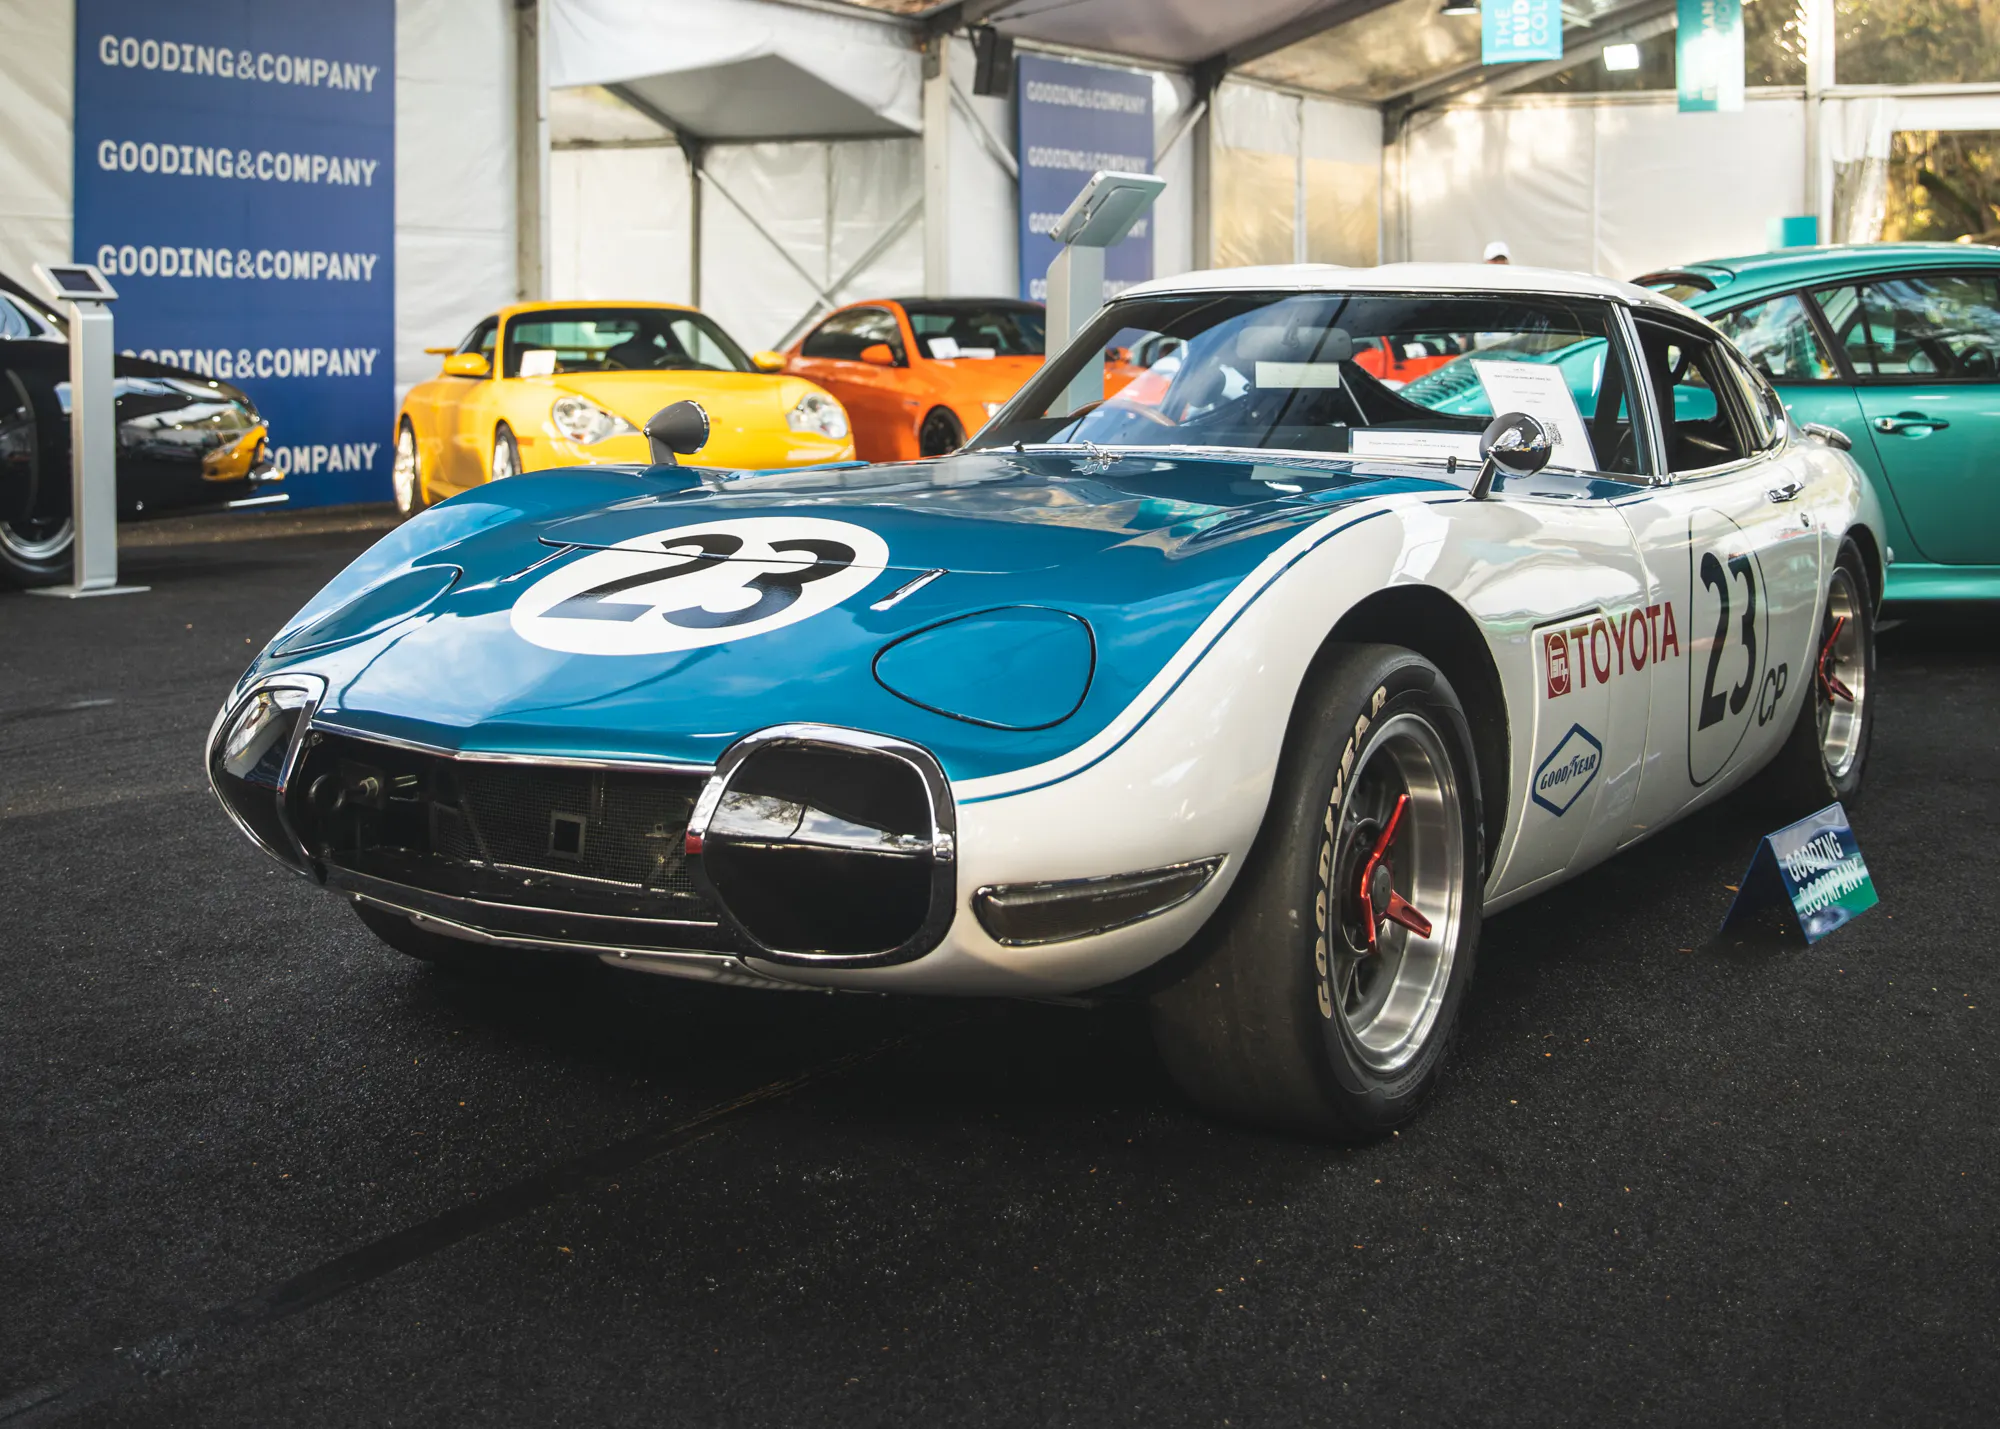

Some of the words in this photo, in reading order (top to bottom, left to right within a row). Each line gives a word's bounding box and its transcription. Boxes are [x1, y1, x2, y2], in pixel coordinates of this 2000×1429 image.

[1494, 8, 1511, 48] THE
[98, 34, 378, 92] GOODING&COMPANY
[1027, 81, 1147, 114] GOODING&COMPANY
[97, 139, 377, 187] GOODING&COMPANY
[97, 244, 377, 281] GOODING&COMPANY
[537, 533, 857, 629] 23
[1570, 601, 1680, 689] TOYOTA
[1697, 551, 1757, 732] 23
[1757, 662, 1788, 728] CP
[1540, 753, 1597, 790] GOODYEAR
[1315, 685, 1388, 1020] GOODYEAR
[1785, 830, 1844, 883] GOODING
[1798, 857, 1864, 917] &COMPANY
